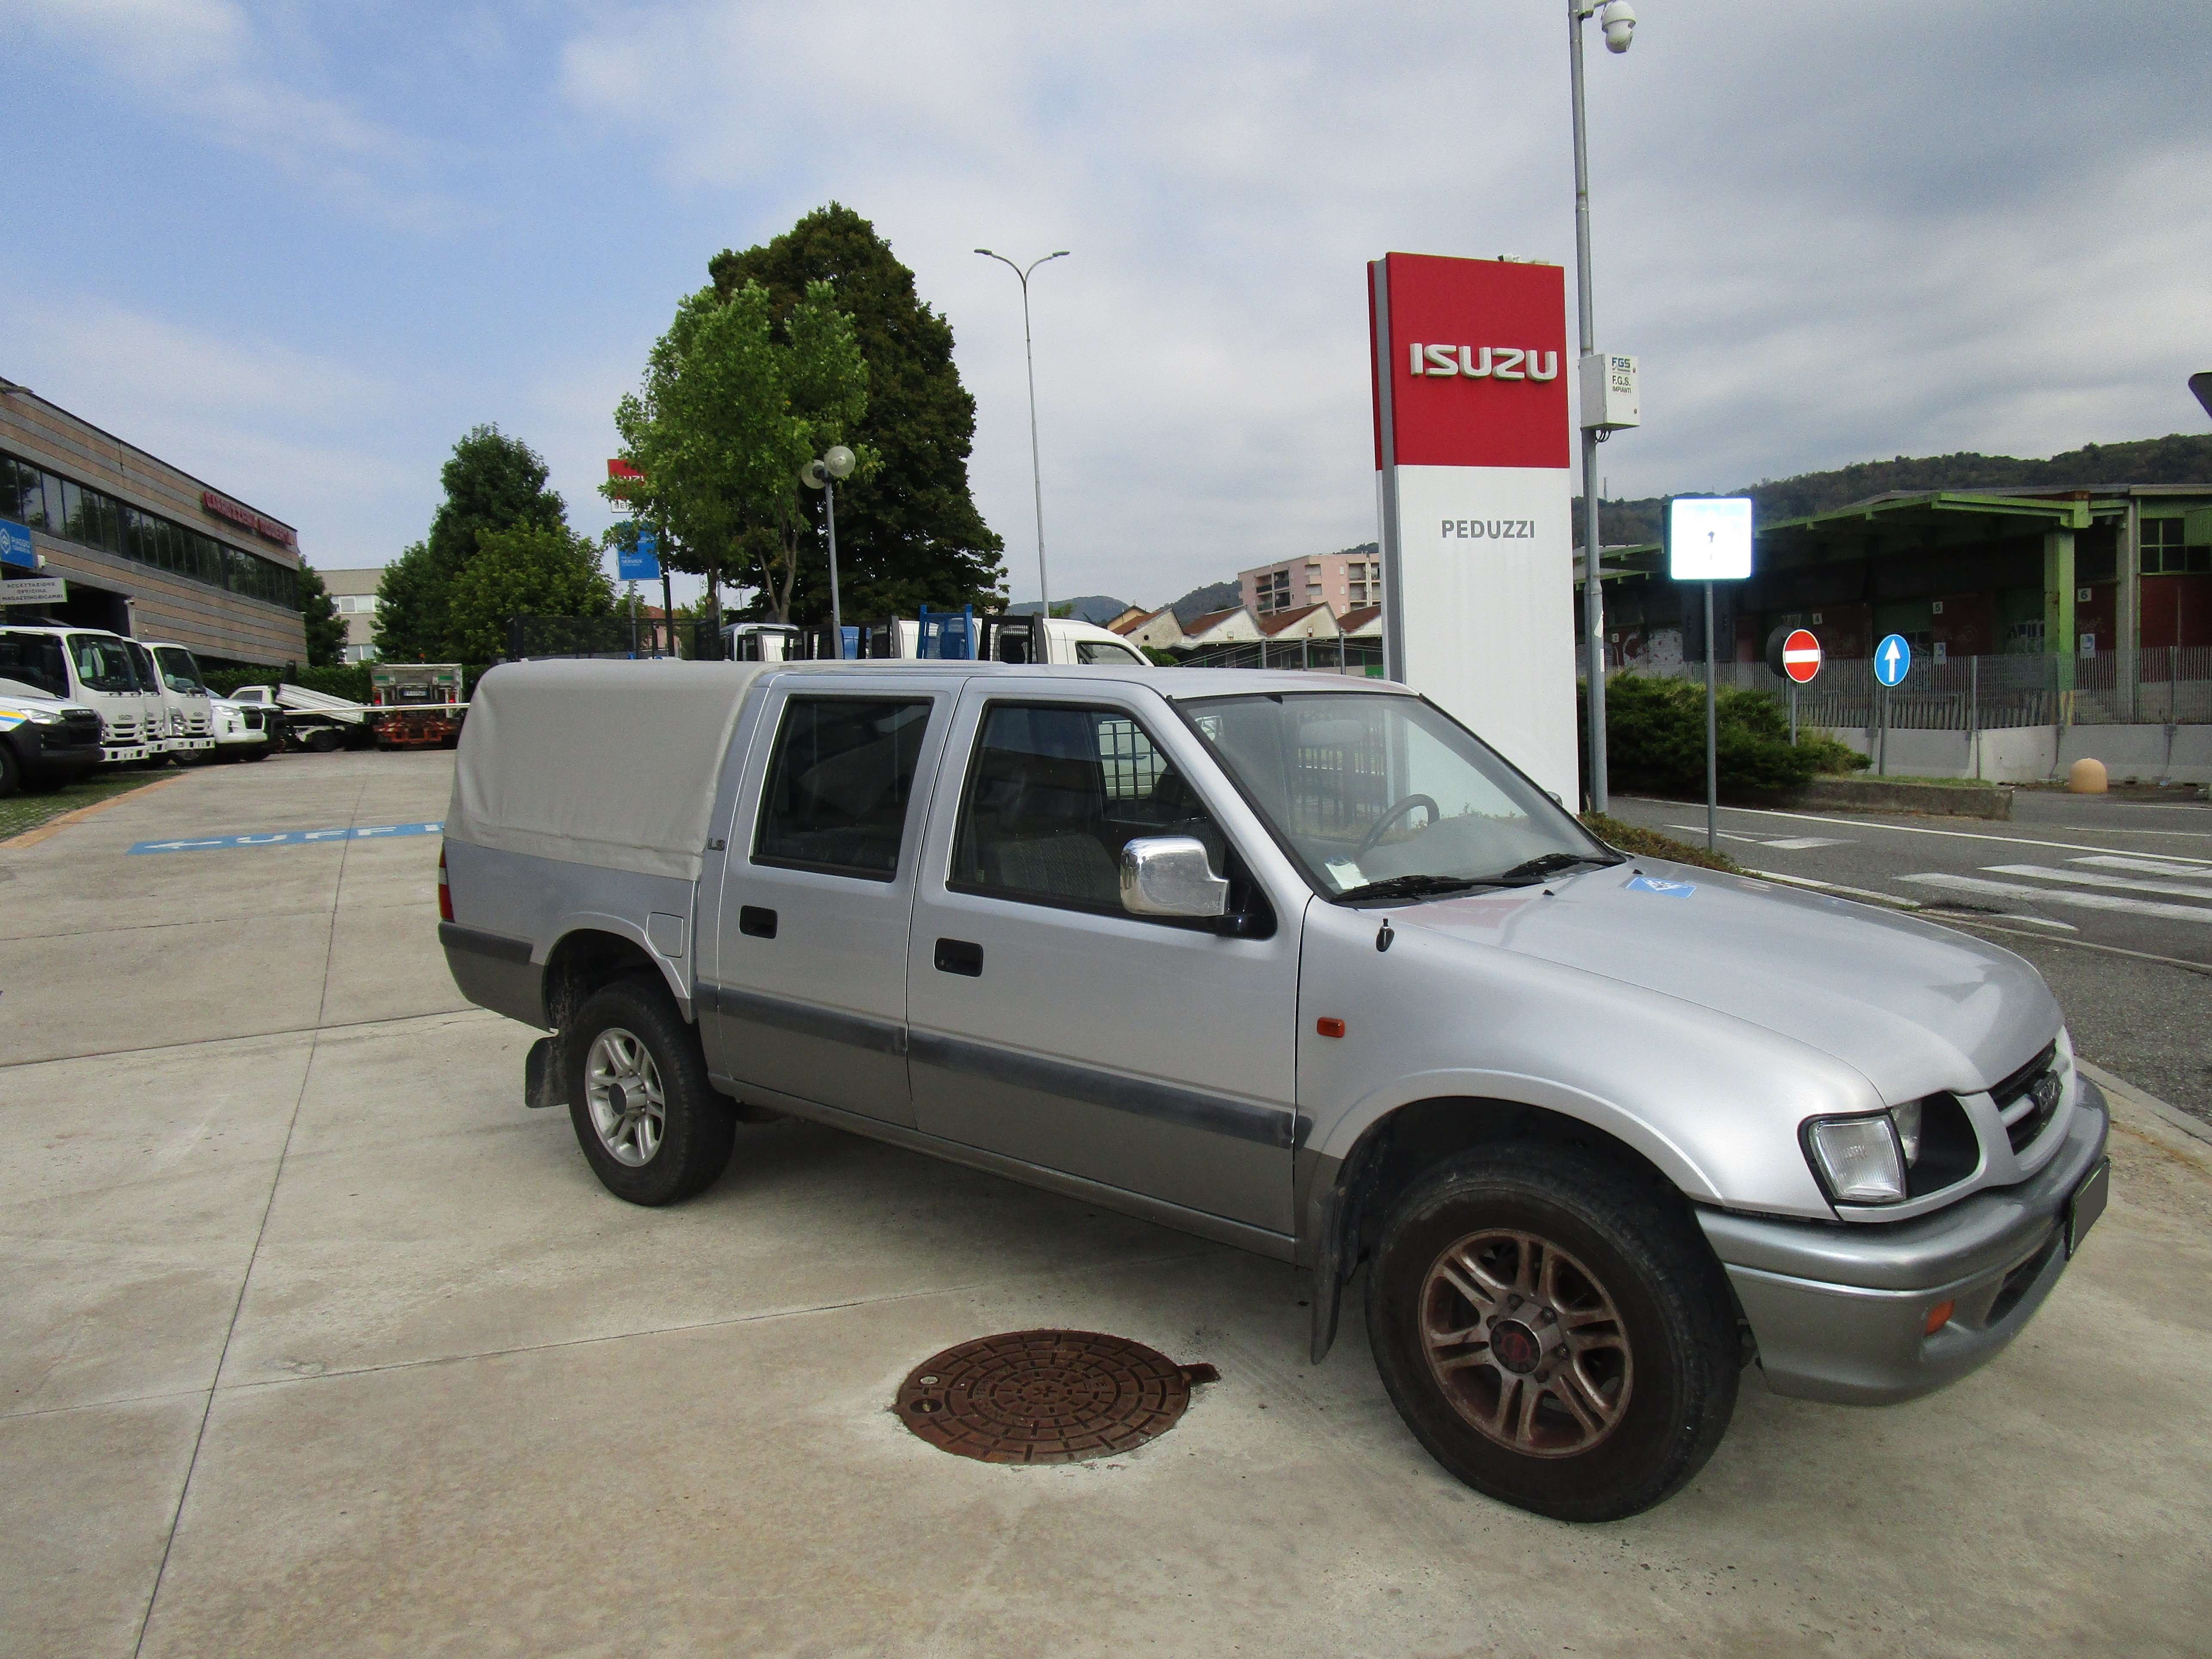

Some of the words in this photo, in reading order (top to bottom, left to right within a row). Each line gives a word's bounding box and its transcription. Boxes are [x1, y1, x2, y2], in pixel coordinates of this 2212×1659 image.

[1410, 343, 1558, 382] ISUZU
[1612, 357, 1630, 368] FGS
[1613, 375, 1631, 386] F.G.S.
[1442, 520, 1534, 539] PEDUZZI
[2081, 590, 2088, 599] 6
[708, 838, 725, 851] LS
